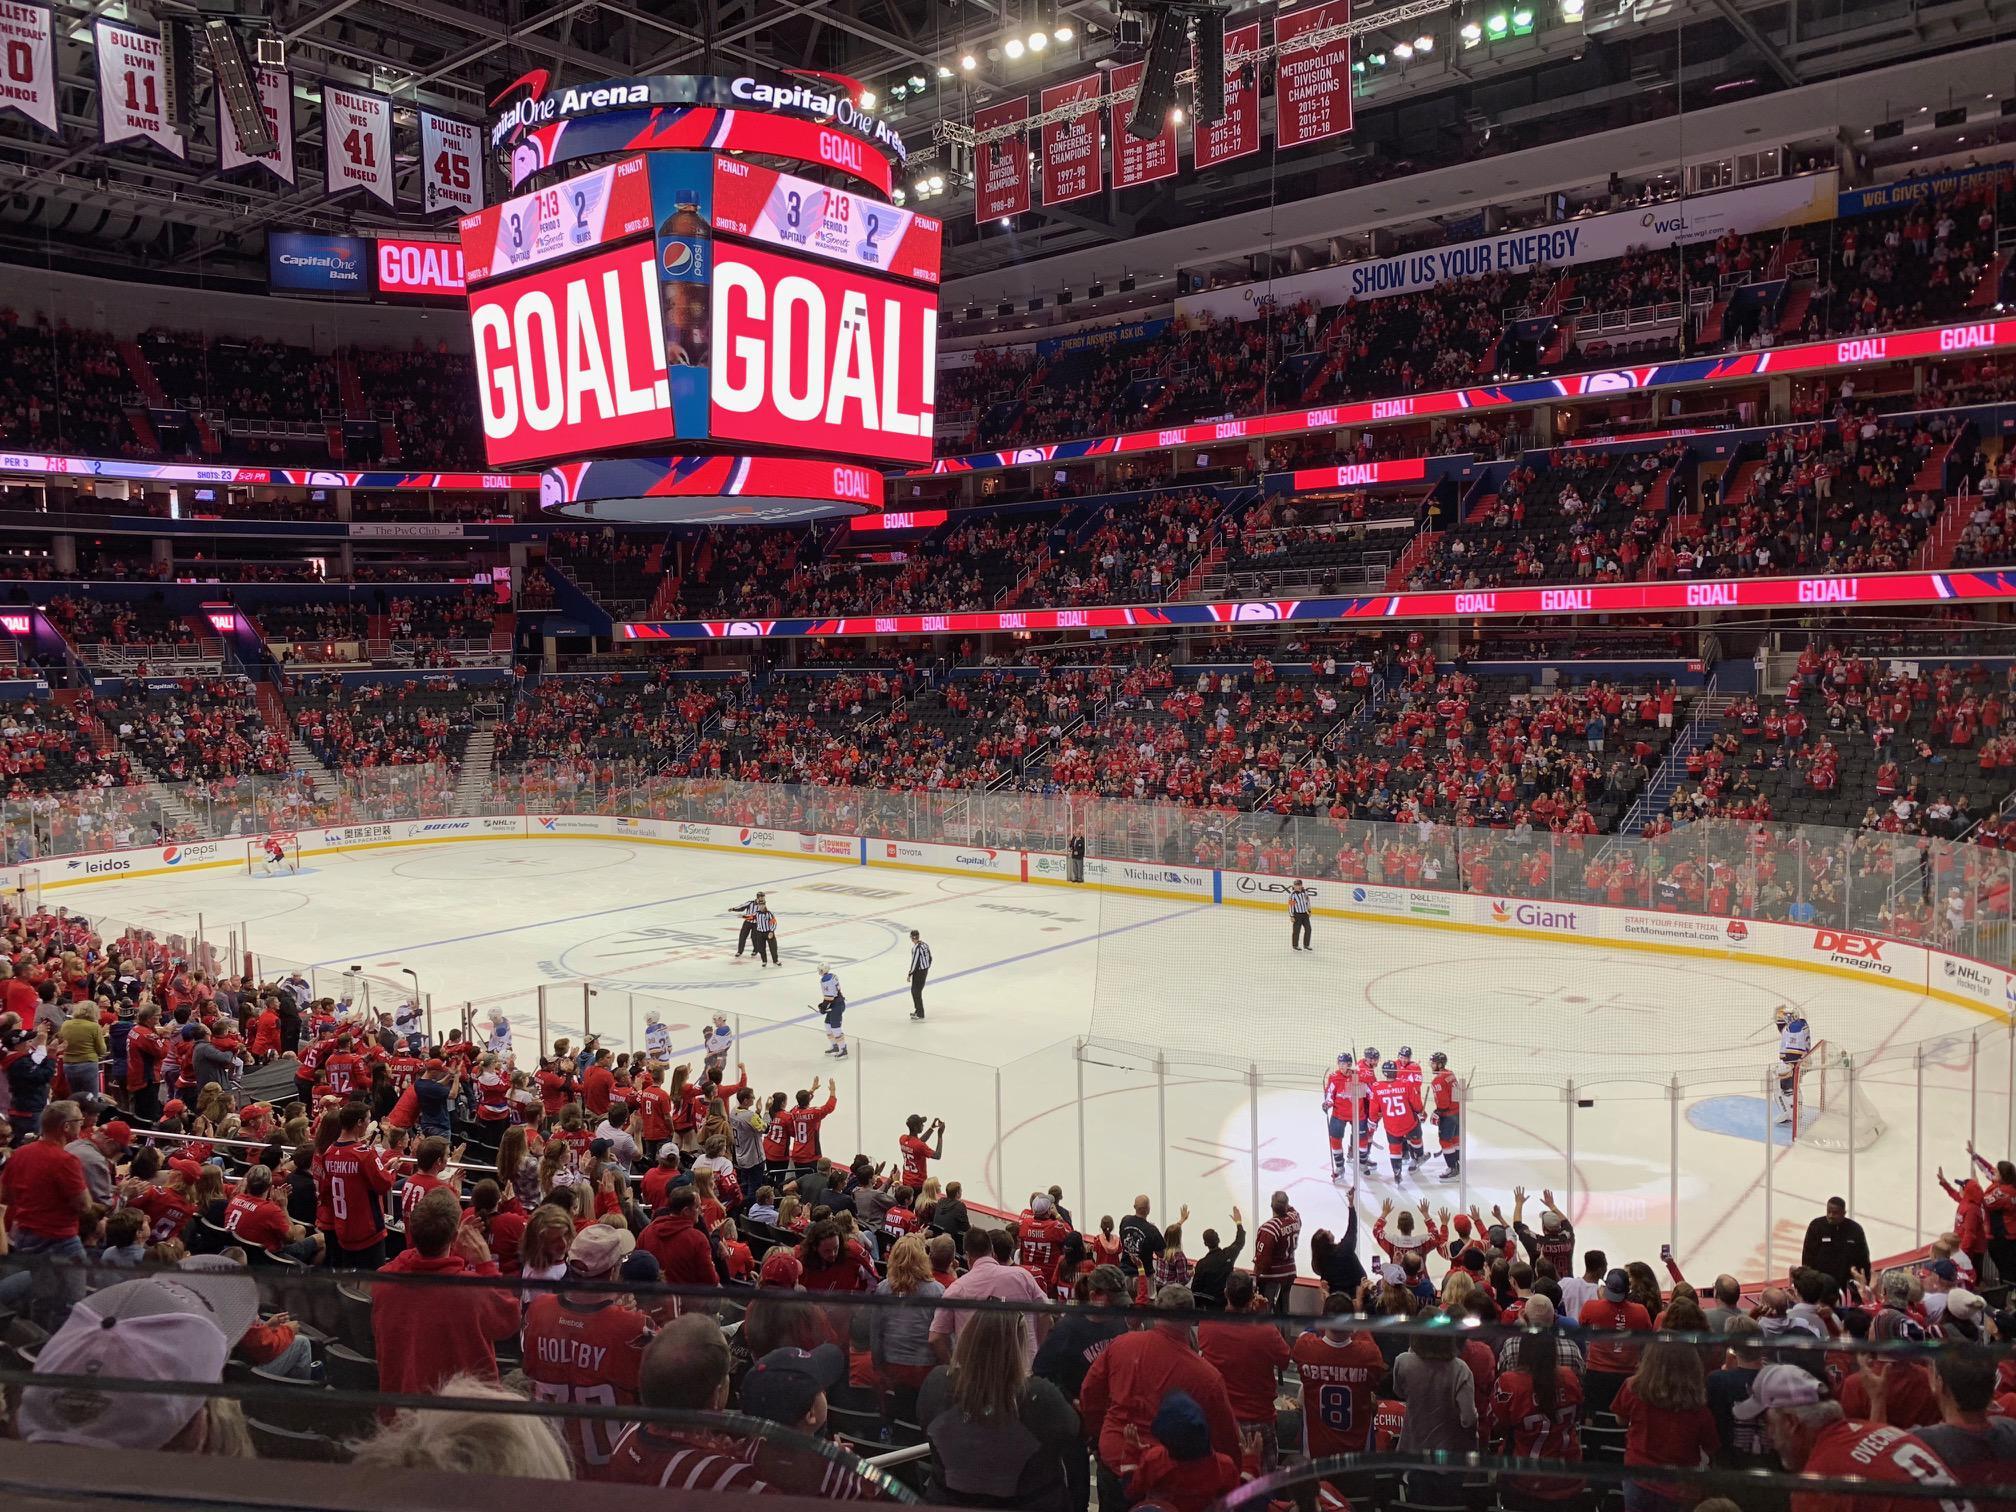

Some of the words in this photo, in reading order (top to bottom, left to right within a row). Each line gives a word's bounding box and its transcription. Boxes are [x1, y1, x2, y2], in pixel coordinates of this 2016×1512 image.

[124, 53, 155, 72] ELVIN
[1281, 49, 1345, 78] METROPOLITAN
[1294, 67, 1332, 88] DIVISION
[123, 70, 159, 115] 11
[560, 84, 649, 114] Arena
[1288, 79, 1340, 102] CHAMPIONS
[334, 92, 380, 115] BULLETS
[731, 77, 837, 116] Capital
[837, 98, 873, 133] One
[1298, 95, 1330, 113] 2015-16
[127, 115, 160, 132] HAYES
[349, 113, 368, 128] WES
[1299, 108, 1330, 126] 2016-17
[431, 117, 472, 139] BULLETS
[1210, 123, 1242, 144] 2015-16
[1299, 121, 1330, 139] 2017-18
[343, 128, 376, 168] 41
[442, 137, 462, 151] PHIL
[819, 131, 862, 172] GOAL!
[1049, 132, 1093, 154] CONFERENCE
[1210, 137, 1242, 158] 2016-17
[1051, 145, 1091, 165] CHAMPIONS
[343, 166, 377, 183] UNSELD
[434, 150, 471, 190] 45
[617, 158, 643, 178] PENALTY
[717, 159, 749, 178] PENALTY
[990, 165, 1015, 181] DIVISION
[1057, 165, 1086, 182] 1997-98
[985, 175, 1019, 193] CHAMPIONS
[1057, 179, 1086, 195] 2017-18
[1862, 190, 1889, 208] WGL
[1892, 182, 1928, 201] GIVES
[1931, 177, 1957, 194] YOU
[437, 187, 472, 204] CHENIER
[535, 190, 560, 221] 7:13
[575, 191, 588, 228] 2
[787, 190, 801, 228] 3
[823, 190, 850, 222] 7:13
[461, 214, 482, 231] PENALTY
[511, 213, 523, 248] 3
[540, 220, 556, 233] PERIOD
[624, 219, 641, 233] SHOTS:
[716, 217, 739, 232] SHOTS:
[739, 222, 747, 234] 24
[823, 219, 842, 232] PERIOD
[843, 223, 848, 234] 3
[866, 213, 879, 249] 2
[914, 216, 939, 233] PENALTY
[1655, 217, 1688, 234] WGL
[576, 231, 592, 245] BLUES
[780, 229, 806, 245] CAPITALS
[825, 233, 850, 248] Sports
[815, 241, 848, 254] WASHINGTON
[380, 245, 465, 288] GOAL!
[510, 250, 531, 265] CAPITALS
[863, 251, 879, 264] BLUES
[1352, 259, 1405, 296] SHOW
[1411, 254, 1436, 284] US
[1439, 244, 1492, 279] YOUR
[1497, 227, 1580, 270] ENERGY
[329, 271, 358, 280] Bank
[1940, 324, 1995, 351] GOAL!
[471, 259, 671, 439] GOAL!
[711, 260, 938, 439] GOAL!
[1838, 338, 1886, 362] GOAL!
[1307, 408, 1338, 427] GOAL!
[1372, 399, 1414, 419] GOAL!
[1159, 429, 1187, 446] GOAL!
[1216, 421, 1246, 439] GOAL!
[4, 457, 22, 467] PER
[23, 459, 29, 468] 3
[44, 457, 67, 472] 7:13
[94, 461, 102, 475] 2
[197, 471, 221, 480] SHOTS:
[221, 471, 232, 480] 23
[483, 475, 512, 489] GOAL!
[833, 467, 870, 500] GOAL!
[1338, 463, 1378, 486] GOAL!
[883, 512, 914, 529] GOAL!
[374, 526, 392, 536] The
[419, 526, 440, 536] Club
[1686, 583, 1738, 607] GOAL!
[1798, 578, 1857, 602] GOAL!
[1455, 593, 1496, 613] GOAL!
[1541, 589, 1592, 611] GOAL!
[875, 618, 897, 632] GOAL!
[922, 615, 949, 631] GOAL!
[999, 613, 1027, 628] GOAL!
[1057, 610, 1087, 627] GOAL!
[423, 822, 470, 831] BOEING
[688, 823, 711, 835] Sports
[752, 831, 775, 842] pepsi
[184, 842, 218, 858] pepsi
[898, 848, 922, 857] TOYOTA
[86, 859, 130, 874] leidos
[1124, 868, 1162, 882] Michael
[1183, 874, 1202, 886] Son
[1516, 904, 1576, 930] Giant
[1625, 916, 1648, 926] START
[1650, 919, 1672, 928] YOUR
[1674, 921, 1693, 930] FREE
[1695, 923, 1718, 932] TRIAL
[1625, 925, 1719, 941] GetMonumental.com
[1813, 930, 1887, 961] DEX
[1830, 953, 1892, 974] imaging
[1382, 1096, 1406, 1117] 25
[332, 1176, 347, 1220] 8
[1027, 1229, 1045, 1239] OSHIE
[1023, 1240, 1051, 1264] 77
[538, 1336, 607, 1371] HOLTBY
[1302, 1363, 1368, 1382] ОВЕЧКИН
[1320, 1384, 1352, 1432] 8
